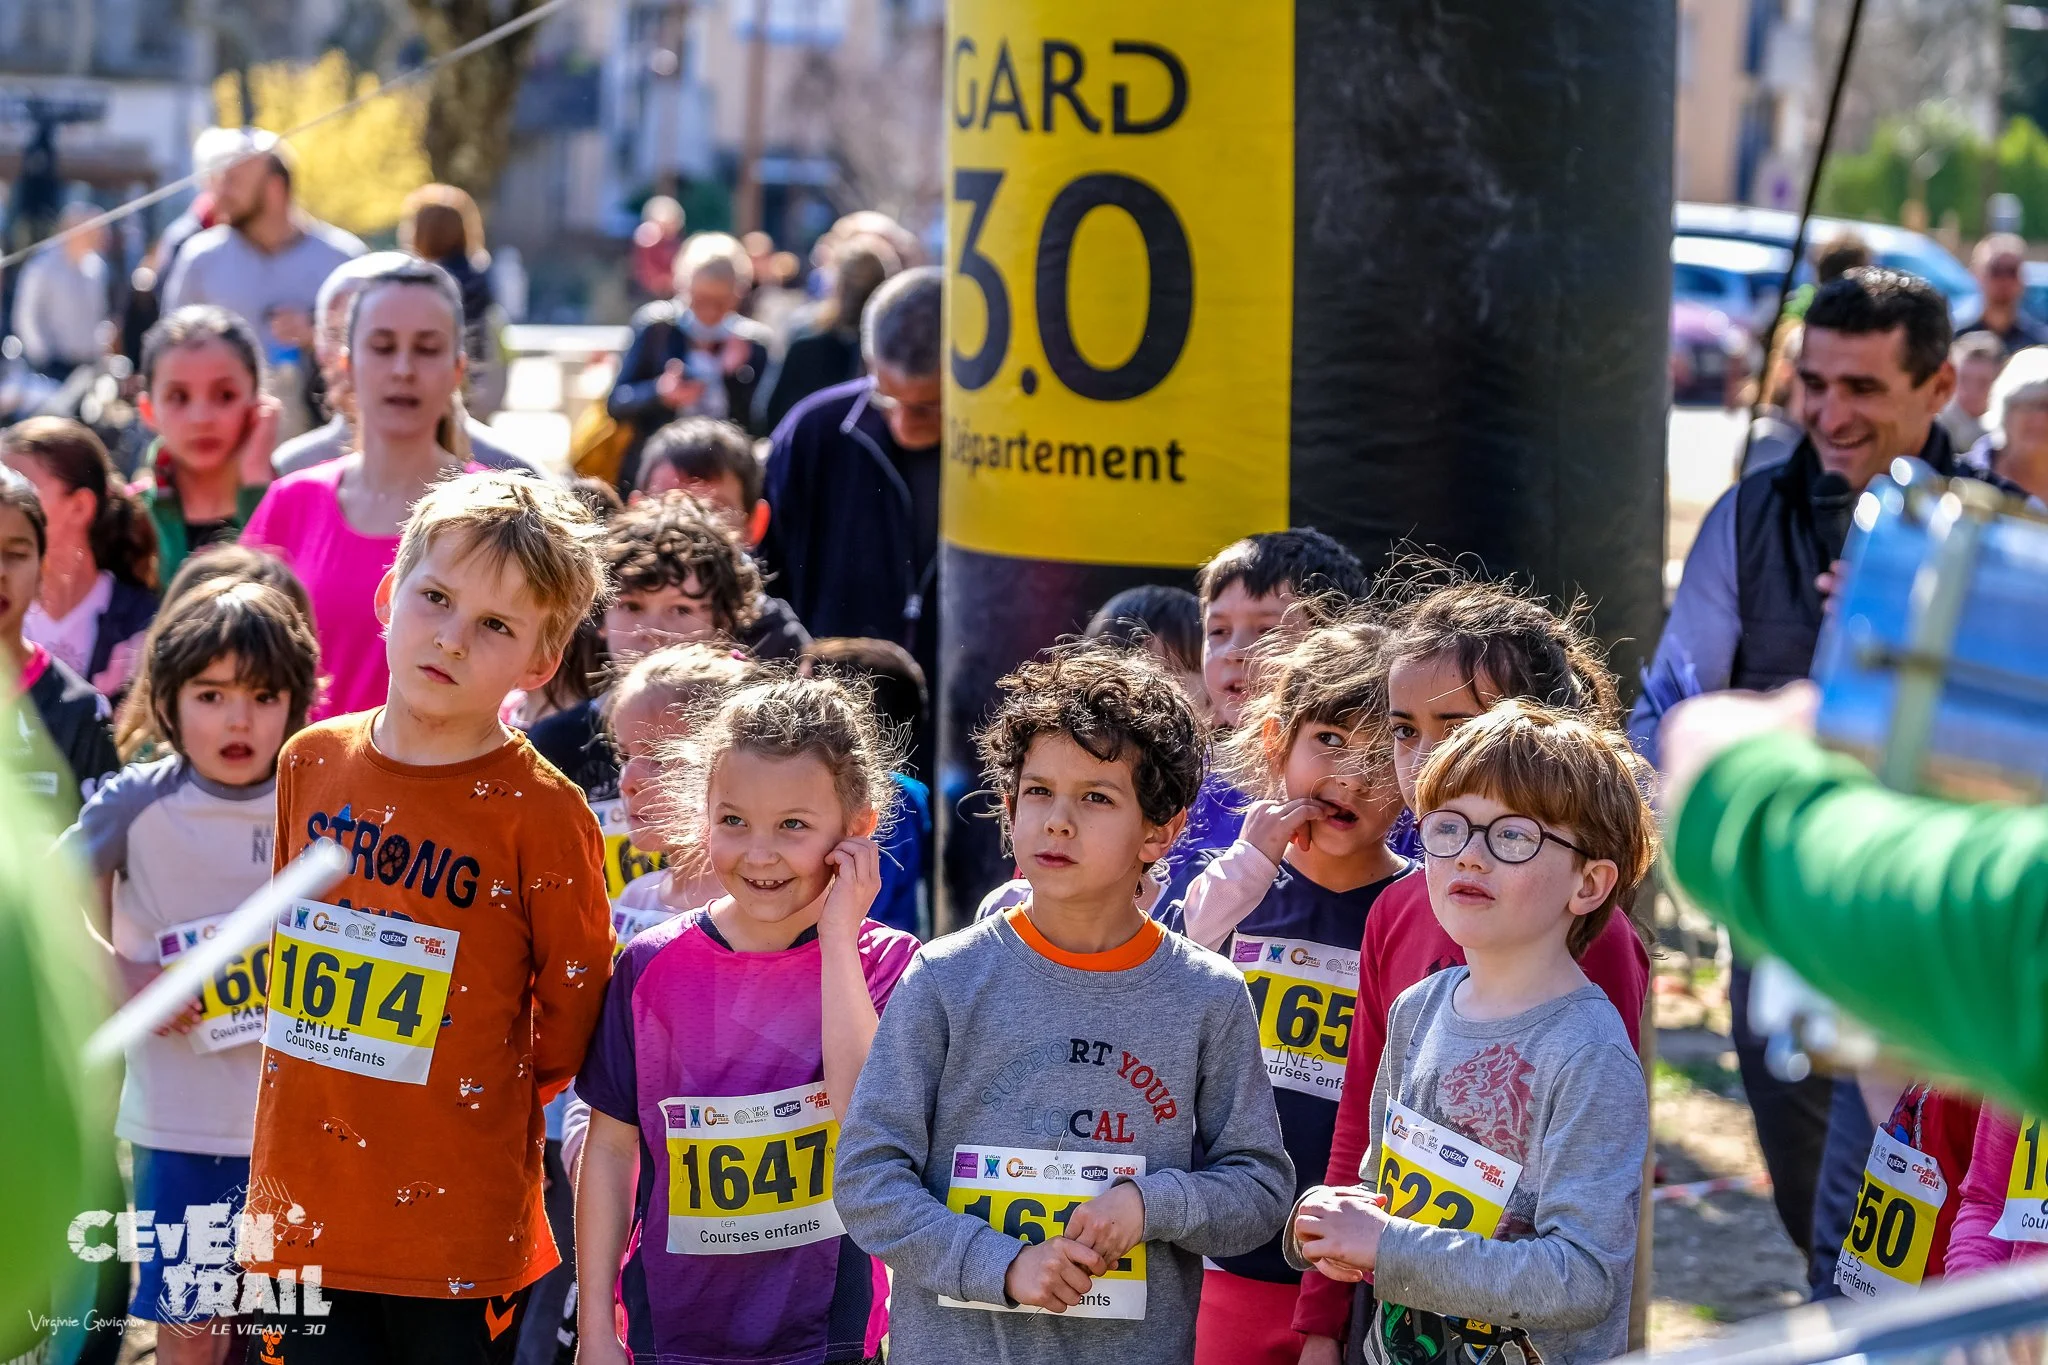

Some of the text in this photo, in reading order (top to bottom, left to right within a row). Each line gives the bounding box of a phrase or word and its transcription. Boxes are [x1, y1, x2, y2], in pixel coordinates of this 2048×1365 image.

[953, 36, 1191, 135] GARD
[301, 811, 481, 909] STRONG
[380, 932, 406, 944] QUÉZAC
[424, 945, 446, 956] TRAIL
[281, 943, 426, 1038] 1614
[210, 1020, 262, 1041] Courses
[285, 1029, 386, 1067] Courses enfants
[1269, 1044, 1324, 1072] INES
[979, 1038, 1178, 1125] SUPPORT YOUR
[775, 1102, 800, 1116] QUÉZAC
[1022, 1105, 1135, 1143] LOCAL
[1441, 1148, 1467, 1165] QUÉZAC
[2024, 1117, 2048, 1190] 1
[682, 1129, 828, 1211] 1647
[1083, 1167, 1107, 1179] QUÉZAC
[1482, 1172, 1505, 1188] TRAIL
[700, 1219, 821, 1244] Courses enfants
[1851, 1180, 1917, 1269] 50
[1842, 1270, 1877, 1297] enfants
